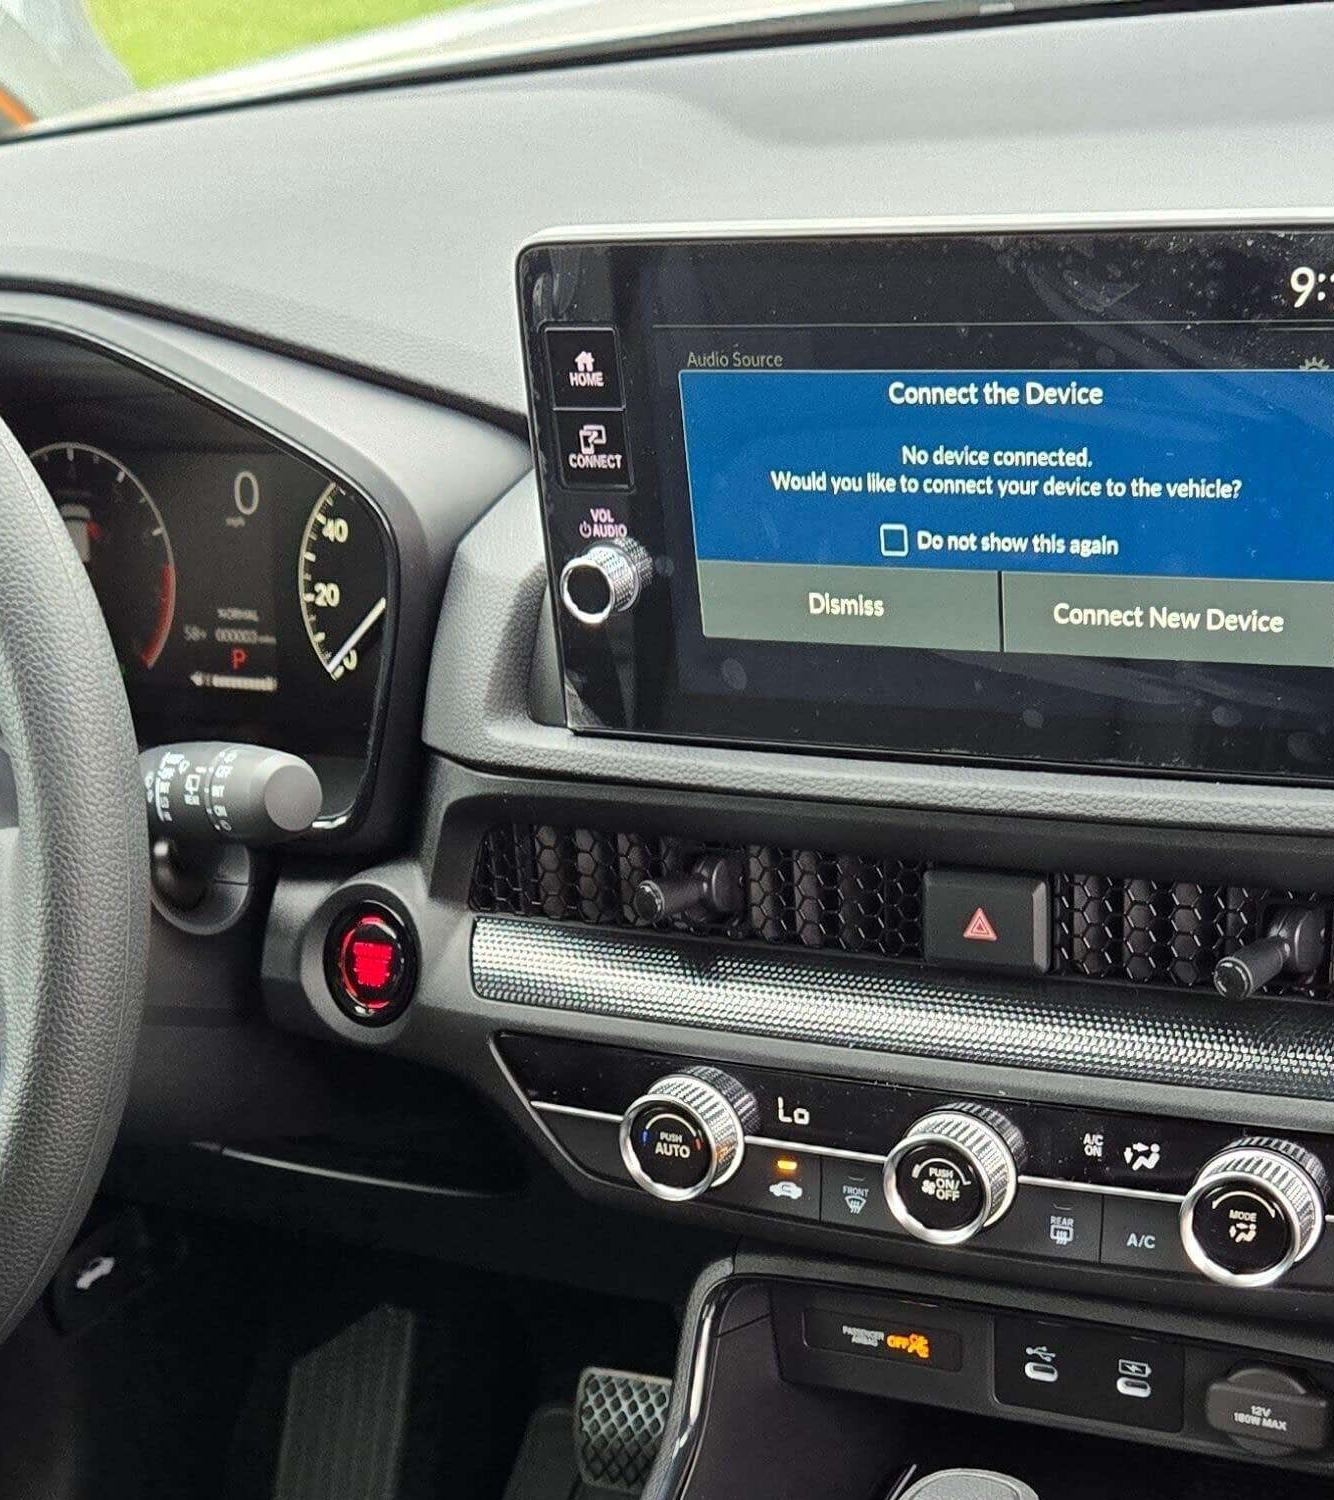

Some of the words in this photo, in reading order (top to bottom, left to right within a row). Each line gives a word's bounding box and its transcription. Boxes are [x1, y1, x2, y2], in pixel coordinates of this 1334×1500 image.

[687, 351, 729, 368] Audio
[733, 352, 783, 368] Source
[569, 371, 605, 388] HOME
[888, 381, 979, 404] Connect
[983, 381, 1020, 404] the
[1026, 381, 1104, 405] Device
[568, 453, 623, 470] CONNECT
[901, 445, 929, 465] No
[932, 445, 990, 466] device
[993, 447, 1094, 468] connected.
[233, 470, 260, 516] 0
[770, 470, 827, 491] Would
[831, 474, 862, 494] you
[867, 472, 896, 492] like
[900, 474, 919, 493] to
[923, 476, 994, 494] connect
[997, 479, 1039, 499] your
[1043, 476, 1103, 497] device
[1106, 478, 1127, 497] to
[1130, 477, 1162, 497] the
[1166, 478, 1243, 499] vehicle?
[590, 508, 615, 523] VOL
[322, 518, 349, 543] 40
[593, 523, 628, 539] AUDIO
[917, 530, 944, 550] Do
[947, 532, 978, 551] not
[981, 532, 1029, 553] show
[1032, 533, 1066, 554] this
[1069, 535, 1120, 558] again
[314, 582, 340, 607] 20
[808, 592, 885, 617] Dismiss
[1053, 602, 1144, 628] Connect
[1149, 606, 1201, 629] New
[1206, 608, 1285, 633] Device
[231, 649, 249, 671] P
[659, 1130, 683, 1144] PUSH
[1083, 1132, 1104, 1146] A/C
[654, 1141, 691, 1159] AUTO
[1084, 1146, 1103, 1158] ON
[928, 1166, 954, 1178] PUSH
[842, 1185, 870, 1197] FRONT
[936, 1177, 961, 1190] ON/
[935, 1189, 961, 1202] OFF
[1050, 1215, 1075, 1227] REAR
[1229, 1209, 1258, 1222] MODE
[1126, 1232, 1156, 1249] A/C
[1251, 1405, 1272, 1418] 12V
[1262, 1417, 1287, 1431] MAX
